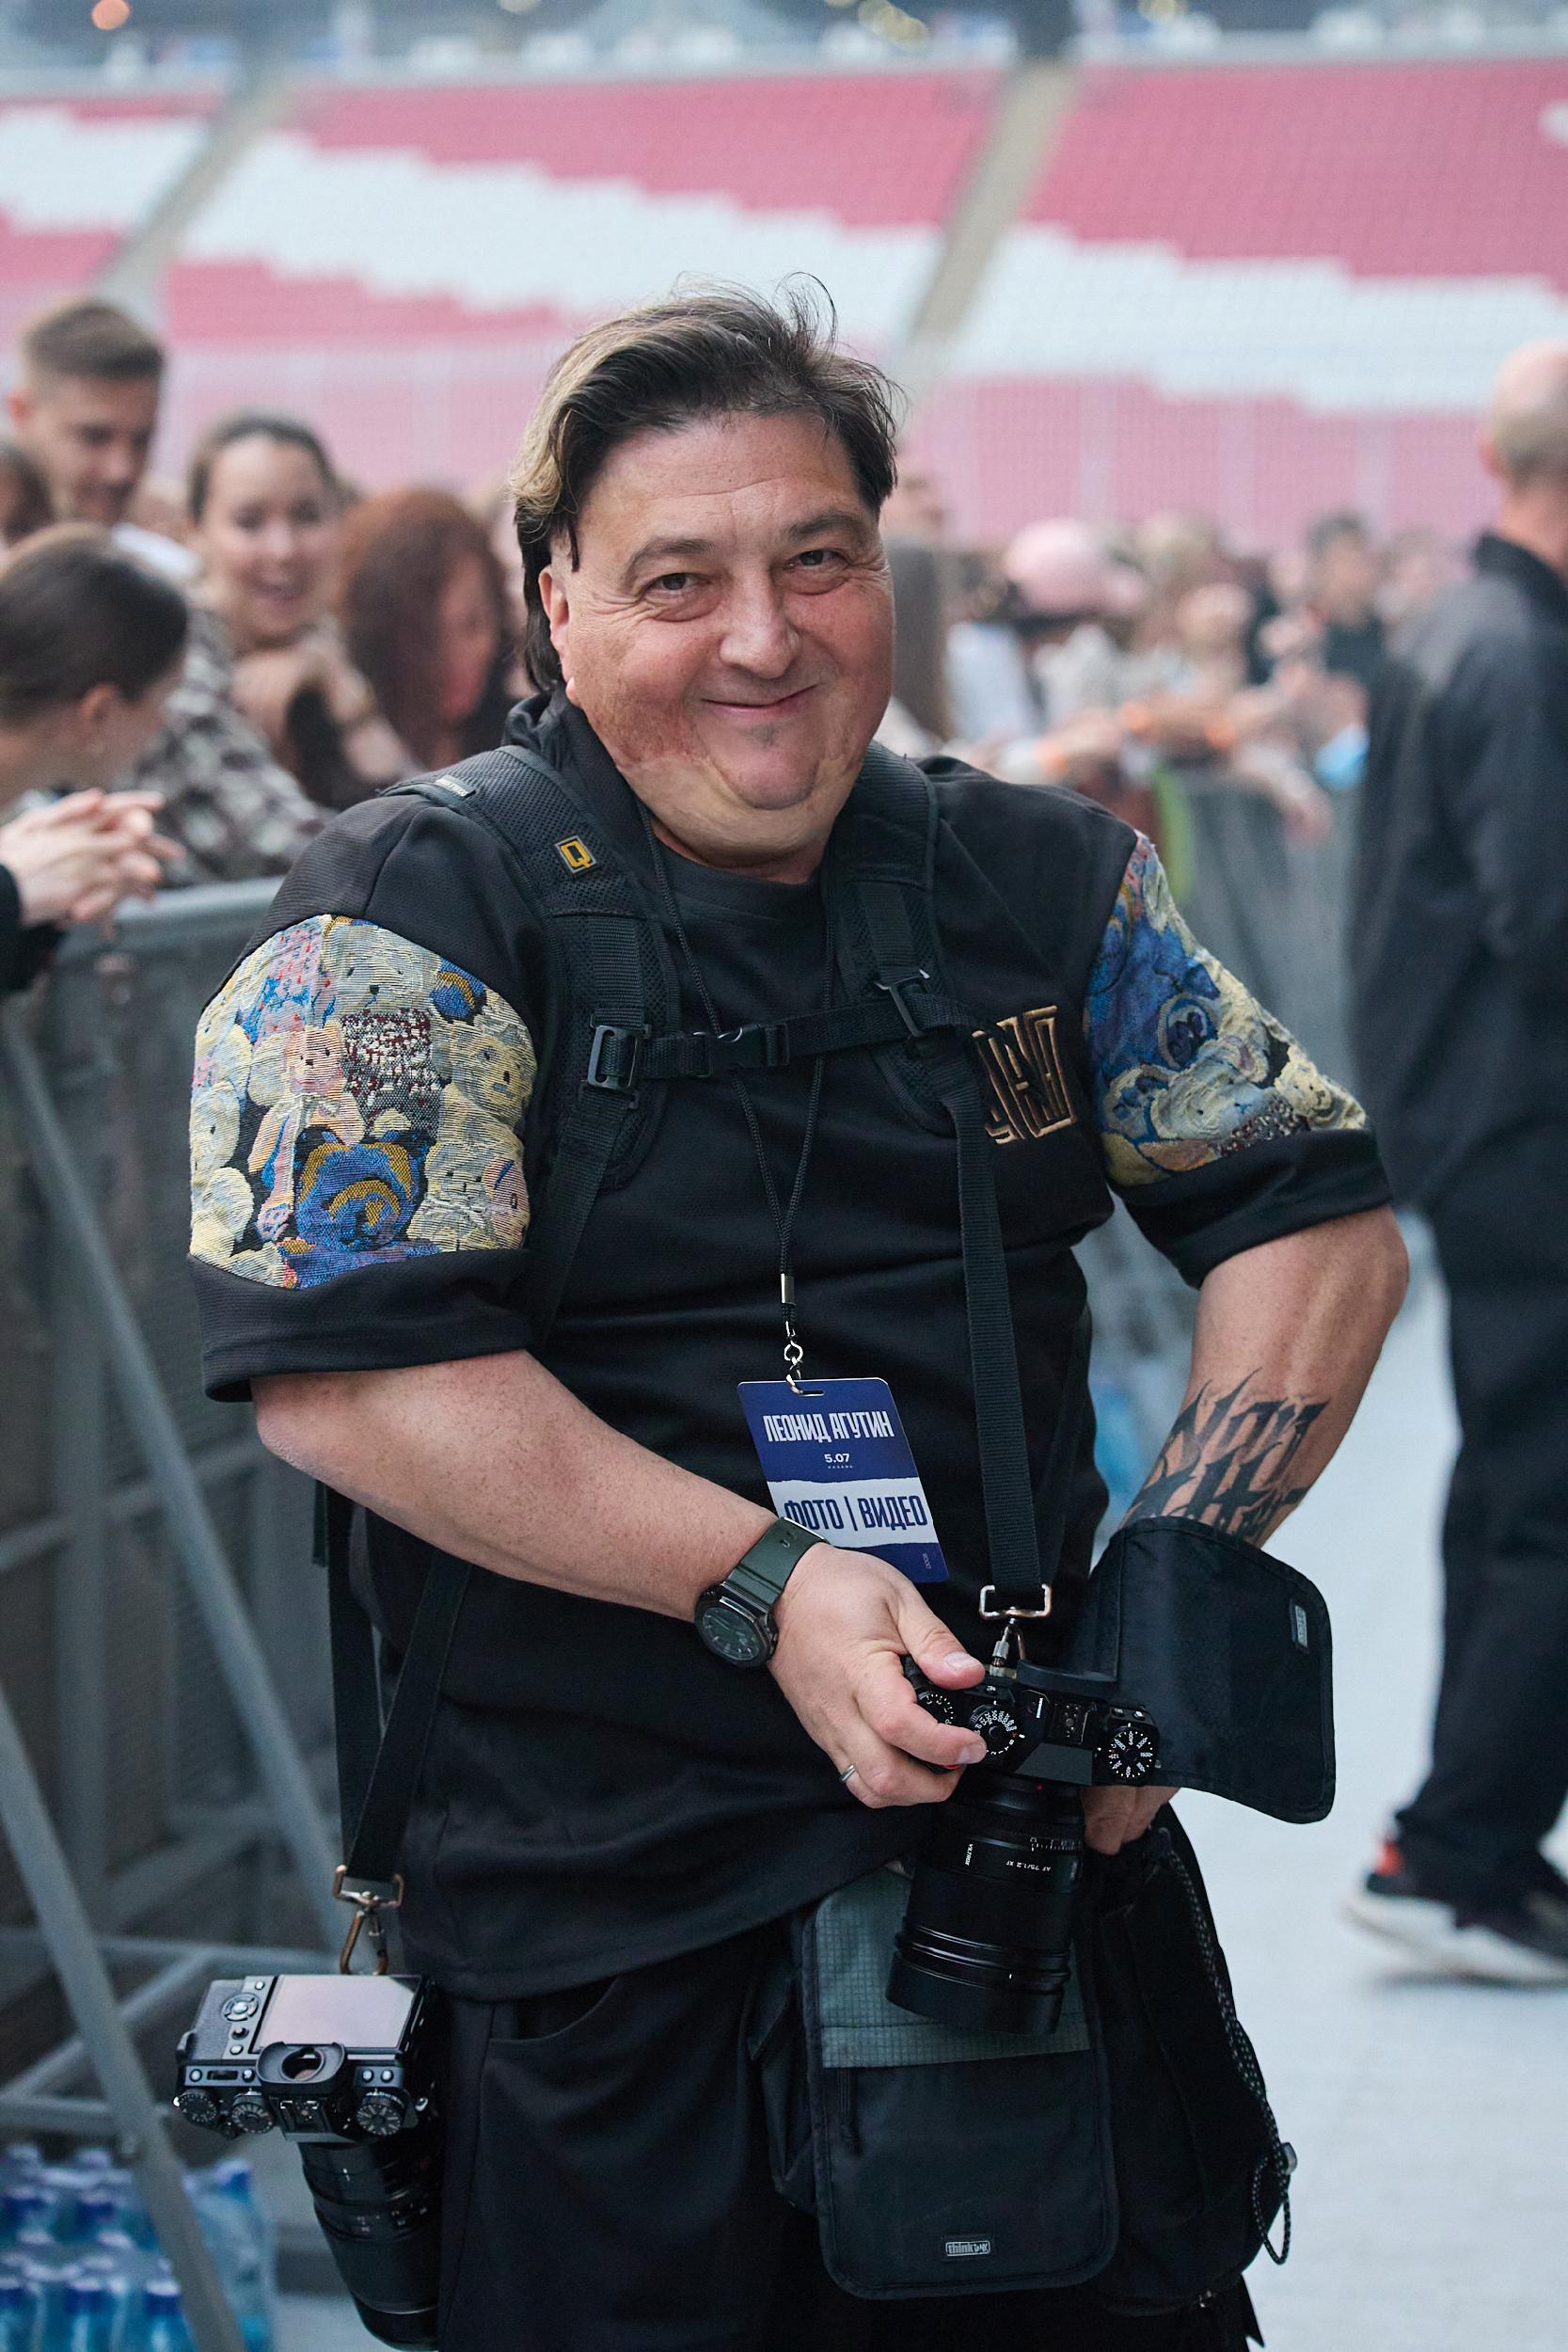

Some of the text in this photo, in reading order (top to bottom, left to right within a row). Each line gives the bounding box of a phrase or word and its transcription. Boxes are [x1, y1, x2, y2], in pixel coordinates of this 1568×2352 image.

[829, 1410, 895, 1439] АГУТИН
[824, 1453, 850, 1463] 5.07
[784, 1499, 845, 1531] ФОТО
[857, 1495, 927, 1531] ВИДЕО
